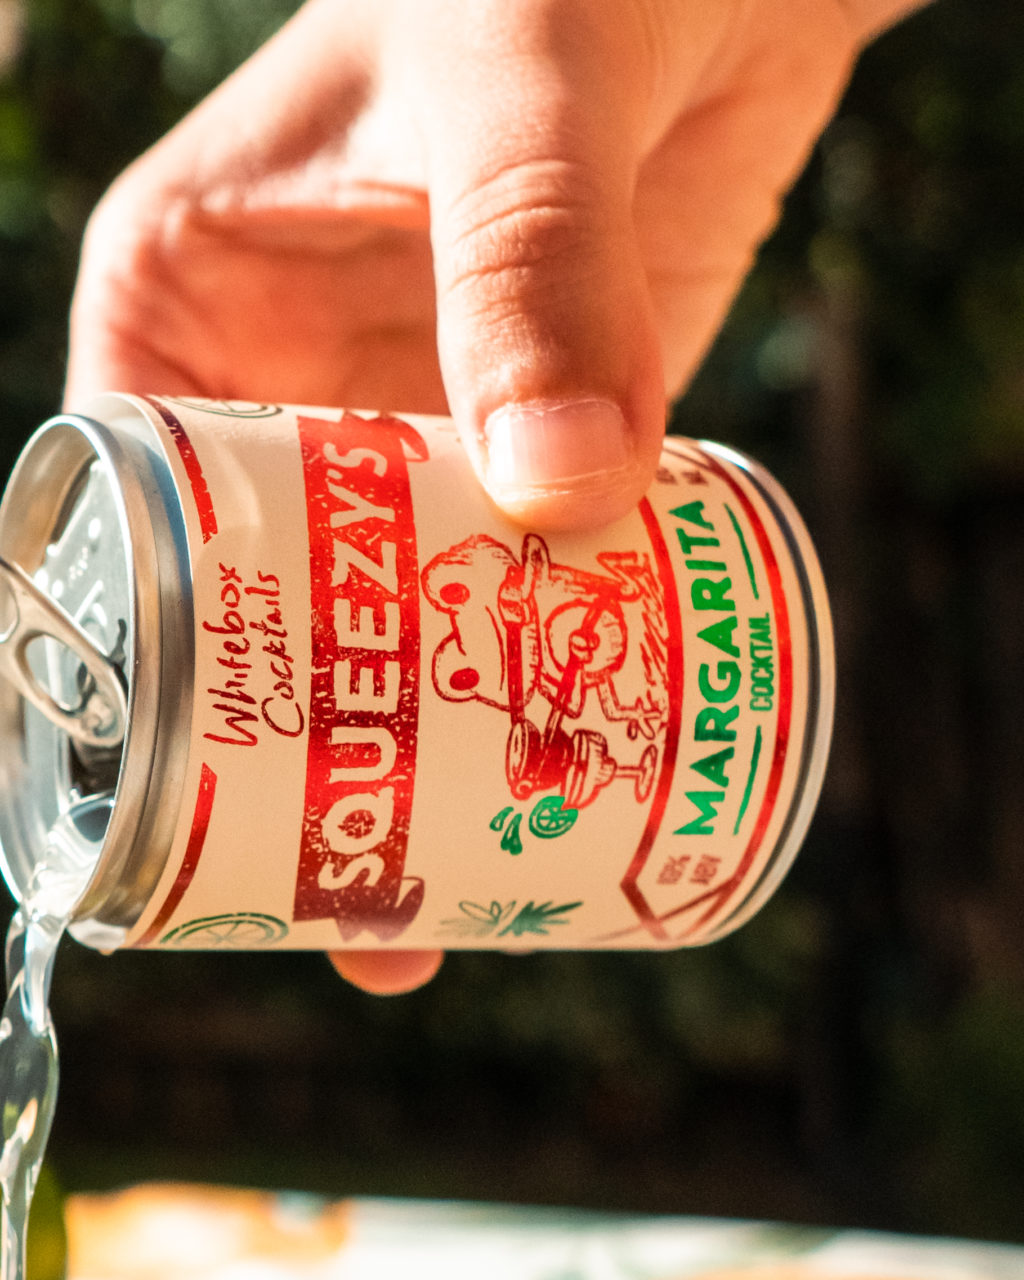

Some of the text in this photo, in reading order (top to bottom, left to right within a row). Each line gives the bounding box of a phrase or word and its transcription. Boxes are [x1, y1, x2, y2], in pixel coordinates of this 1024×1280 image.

[203, 562, 259, 747] Whitebox
[245, 570, 305, 738] Cocktails
[318, 441, 400, 891] SQUEEZY'S
[668, 500, 741, 836] MARGARITA
[749, 612, 777, 712] COCKTAIL
